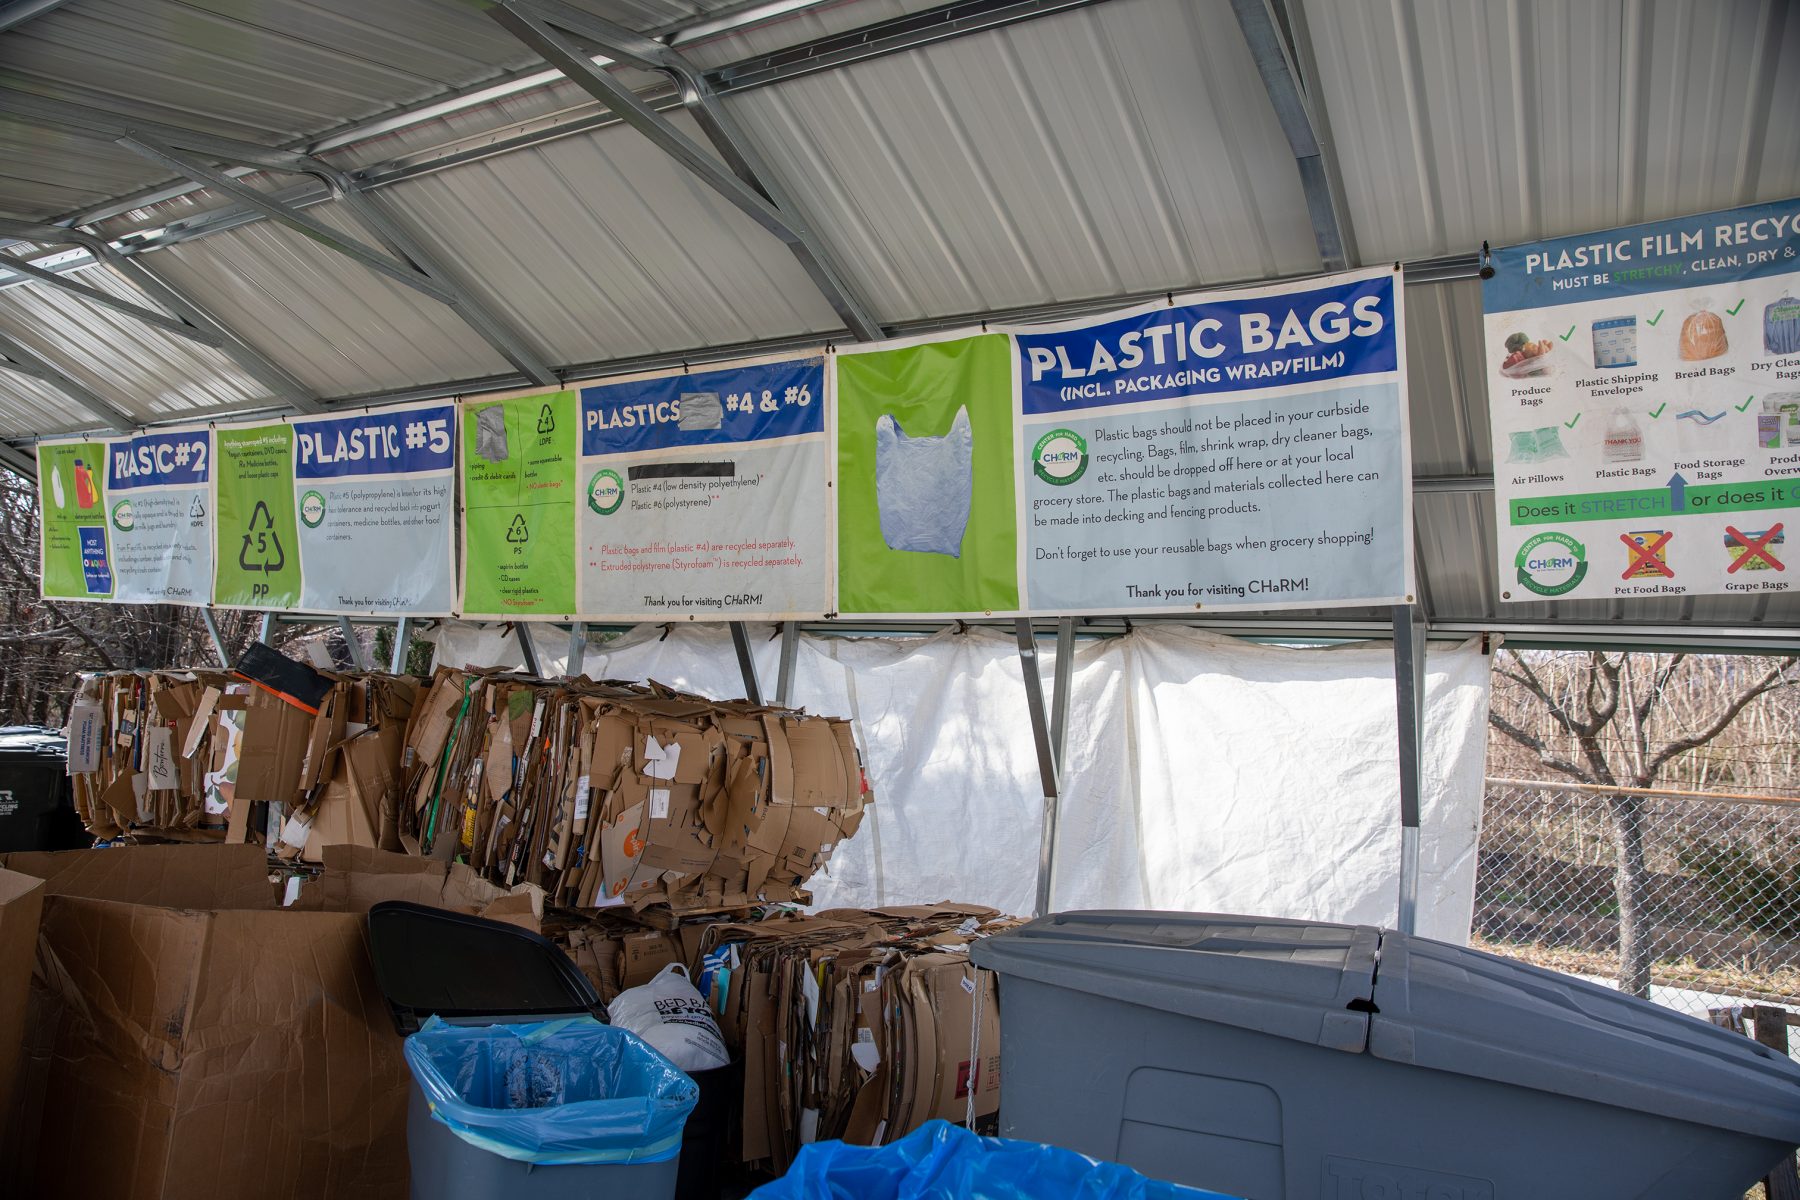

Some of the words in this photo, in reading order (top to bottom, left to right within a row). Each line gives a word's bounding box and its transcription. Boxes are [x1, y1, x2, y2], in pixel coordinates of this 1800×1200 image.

[1525, 240, 1632, 274] PLASTIC
[1641, 228, 1703, 259] FILM
[1552, 275, 1589, 291] MUST
[1593, 272, 1609, 286] BE
[1691, 254, 1742, 273] CLEAN,
[1746, 248, 1778, 264] DRY
[1783, 246, 1796, 258] &
[1027, 317, 1227, 382] PLASTIC
[1238, 295, 1385, 355] BAGS
[1674, 368, 1707, 381] Bread
[1709, 365, 1736, 378] Bags
[1751, 360, 1772, 373] Dry
[1060, 384, 1111, 402] (INCL.
[1115, 367, 1221, 395] PACKAGING
[1225, 350, 1346, 382] WRAP/FILM)
[1575, 376, 1609, 389] Plastic
[1611, 371, 1659, 387] Shipping
[1511, 385, 1551, 397] Produce
[1590, 383, 1643, 397] Envelopes
[586, 399, 680, 432] PLASTICS
[726, 391, 754, 414] #4
[759, 389, 780, 412] &
[784, 384, 811, 407] #6
[1520, 396, 1544, 408] Bags
[1095, 428, 1129, 442] Plastic
[1132, 425, 1158, 440] bags
[1160, 417, 1192, 436] should
[1194, 419, 1213, 431] not
[1216, 416, 1231, 429] be
[1234, 410, 1272, 431] placed
[1274, 412, 1285, 423] in
[1288, 411, 1314, 425] your
[1316, 399, 1370, 418] curbside
[299, 424, 400, 464] PLASTIC
[405, 418, 450, 454] #5
[1096, 446, 1145, 464] recycling.
[1147, 444, 1177, 459] Bags,
[1179, 440, 1199, 455] film,
[1201, 435, 1235, 452] shrink
[1238, 438, 1269, 450] wrap,
[1271, 431, 1291, 447] dry
[1293, 428, 1338, 443] cleaner
[1340, 424, 1373, 440] bags,
[1097, 472, 1117, 483] etc.
[1120, 465, 1155, 481] should
[1157, 464, 1171, 477] be
[1173, 459, 1216, 477] dropped
[1218, 457, 1234, 472] off
[1236, 456, 1263, 470] here
[1265, 458, 1279, 468] or
[1281, 454, 1293, 466] at
[1295, 454, 1322, 468] your
[1325, 445, 1354, 461] local
[1673, 459, 1700, 471] Food
[1702, 456, 1745, 470] Storage
[1511, 475, 1526, 485] Air
[1528, 473, 1564, 484] Pillows
[1595, 468, 1628, 479] Plastic
[1630, 466, 1657, 478] Bags
[1696, 468, 1723, 480] Bags
[631, 483, 651, 494] Plastic
[652, 483, 662, 492] #4
[663, 479, 677, 493] (low
[679, 478, 706, 491] density
[1033, 495, 1073, 510] grocery
[1076, 494, 1105, 506] store.
[1107, 488, 1129, 502] The
[1131, 486, 1165, 503] plastic
[1168, 484, 1191, 500] bags
[1193, 480, 1211, 495] and
[1214, 476, 1265, 494] materials
[1268, 470, 1322, 489] collected
[1325, 470, 1354, 484] here
[1357, 471, 1379, 482] can
[631, 500, 651, 511] Plastic
[1517, 504, 1559, 518] Does
[1564, 502, 1576, 516] it
[1581, 495, 1665, 515] STRETCH
[1691, 494, 1711, 506] or
[1717, 488, 1765, 506] does
[1771, 486, 1785, 501] it
[1034, 513, 1047, 526] be
[1050, 512, 1080, 526] made
[1082, 511, 1102, 524] into
[1104, 507, 1145, 523] decking
[1147, 504, 1167, 519] and
[1170, 504, 1206, 521] fencing
[1208, 500, 1261, 518] products.
[353, 517, 379, 527] medicine
[515, 526, 521, 535] 6
[257, 532, 267, 553] 5
[513, 546, 522, 555] PS
[601, 544, 623, 555] Plastic
[624, 544, 639, 557] bags
[725, 537, 756, 553] recycled
[758, 536, 796, 551] separately.
[1035, 547, 1064, 560] Don't
[1067, 545, 1097, 561] forget
[1100, 546, 1111, 557] to
[1113, 548, 1131, 557] use
[1134, 547, 1159, 558] your
[1161, 538, 1205, 554] reusable
[1207, 537, 1233, 555] bags
[1235, 535, 1267, 549] when
[1269, 537, 1315, 551] grocery
[1317, 527, 1374, 547] shopping!
[601, 559, 631, 571] Extruded
[632, 559, 670, 572] polystyrene
[731, 555, 763, 570] recycled
[764, 553, 803, 568] separately.
[252, 583, 270, 599] PP
[1126, 584, 1161, 598] Thank
[1164, 588, 1185, 600] you
[1187, 582, 1203, 596] for
[1206, 584, 1245, 597] visiting
[1248, 577, 1309, 594] CHaRM!
[1614, 585, 1627, 596] Pet
[1629, 584, 1659, 595] Food
[1661, 583, 1687, 596] Bags
[1725, 581, 1759, 594] Grape
[1760, 579, 1789, 592] Bags
[644, 595, 665, 607] Thank
[667, 598, 680, 608] you
[681, 595, 693, 606] for
[695, 596, 722, 609] visiting
[654, 998, 687, 1011] BED
